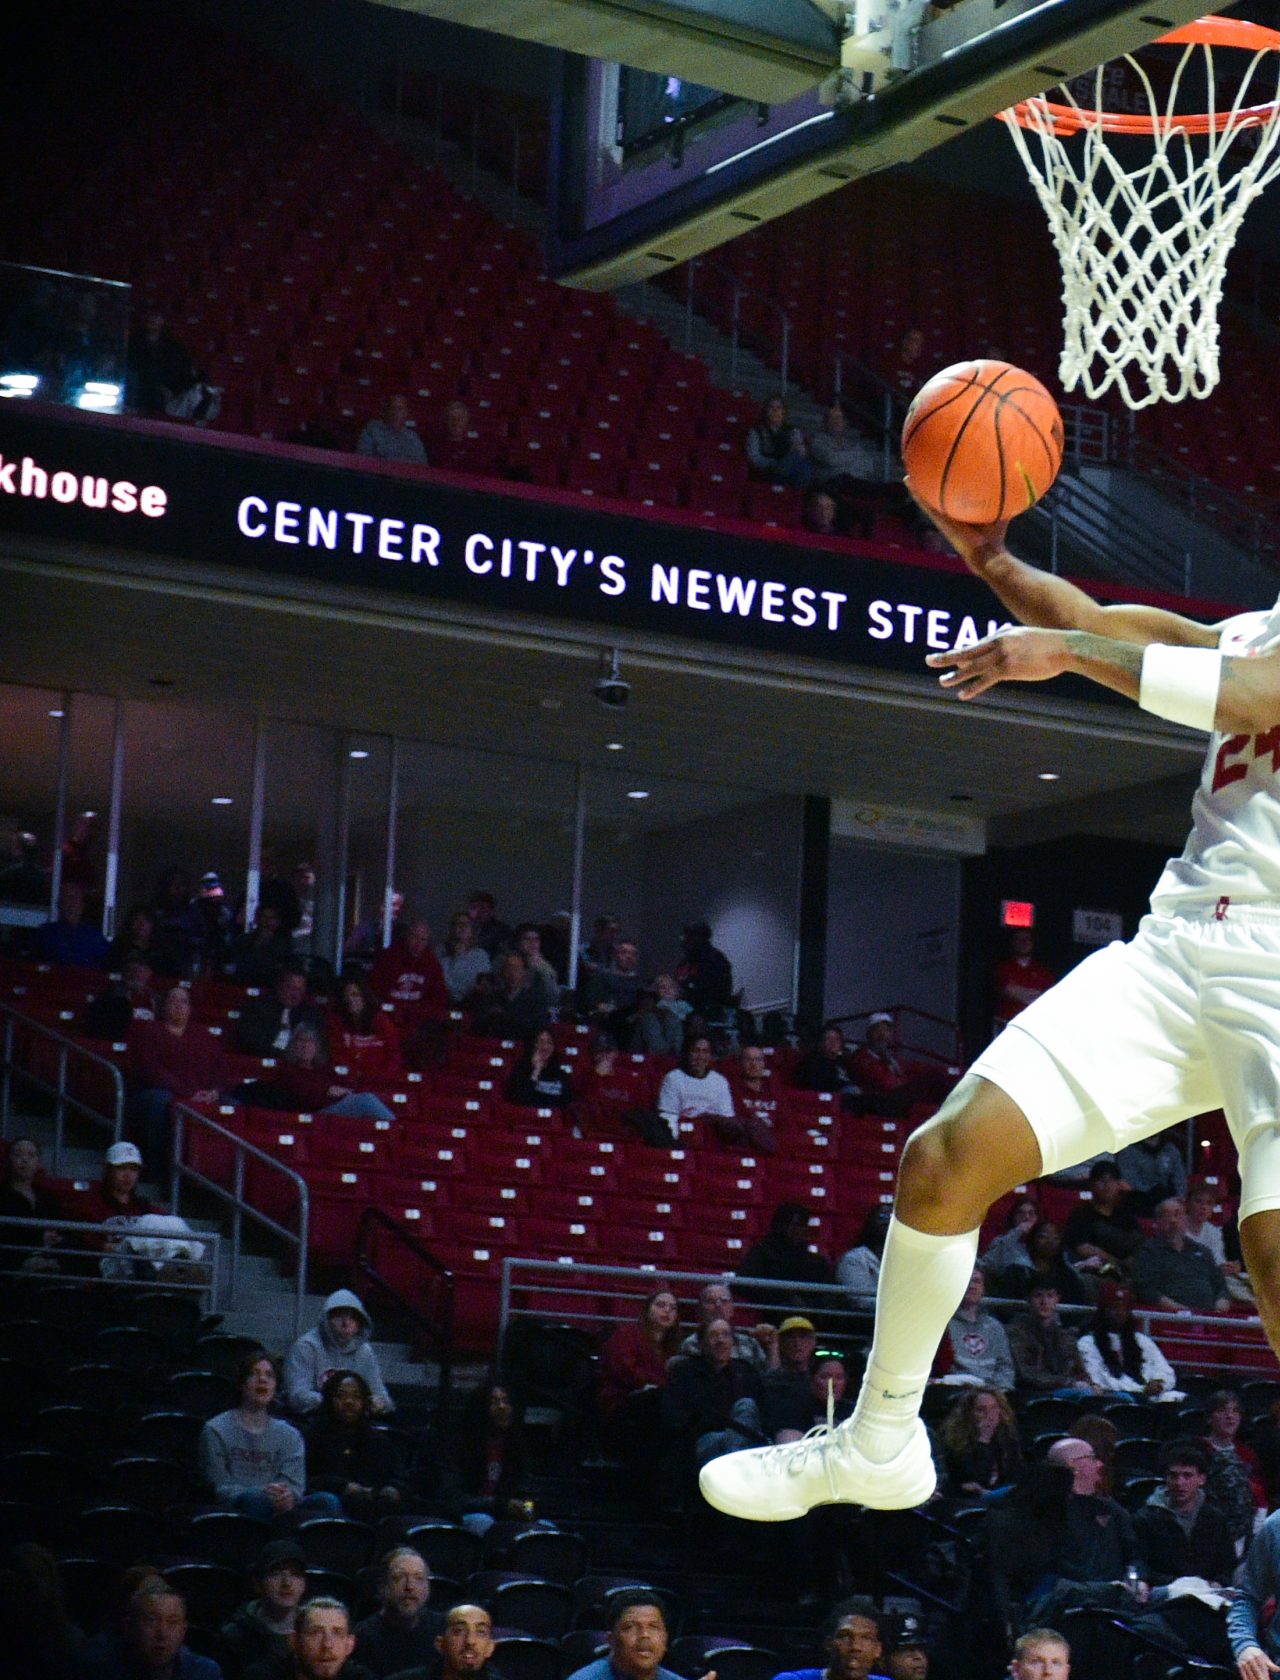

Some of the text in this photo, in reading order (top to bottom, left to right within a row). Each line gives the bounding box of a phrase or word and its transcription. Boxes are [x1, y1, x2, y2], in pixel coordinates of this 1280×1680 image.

[237, 496, 442, 566] CENTER
[464, 533, 627, 596] CITY'S
[651, 563, 848, 631] NEWEST
